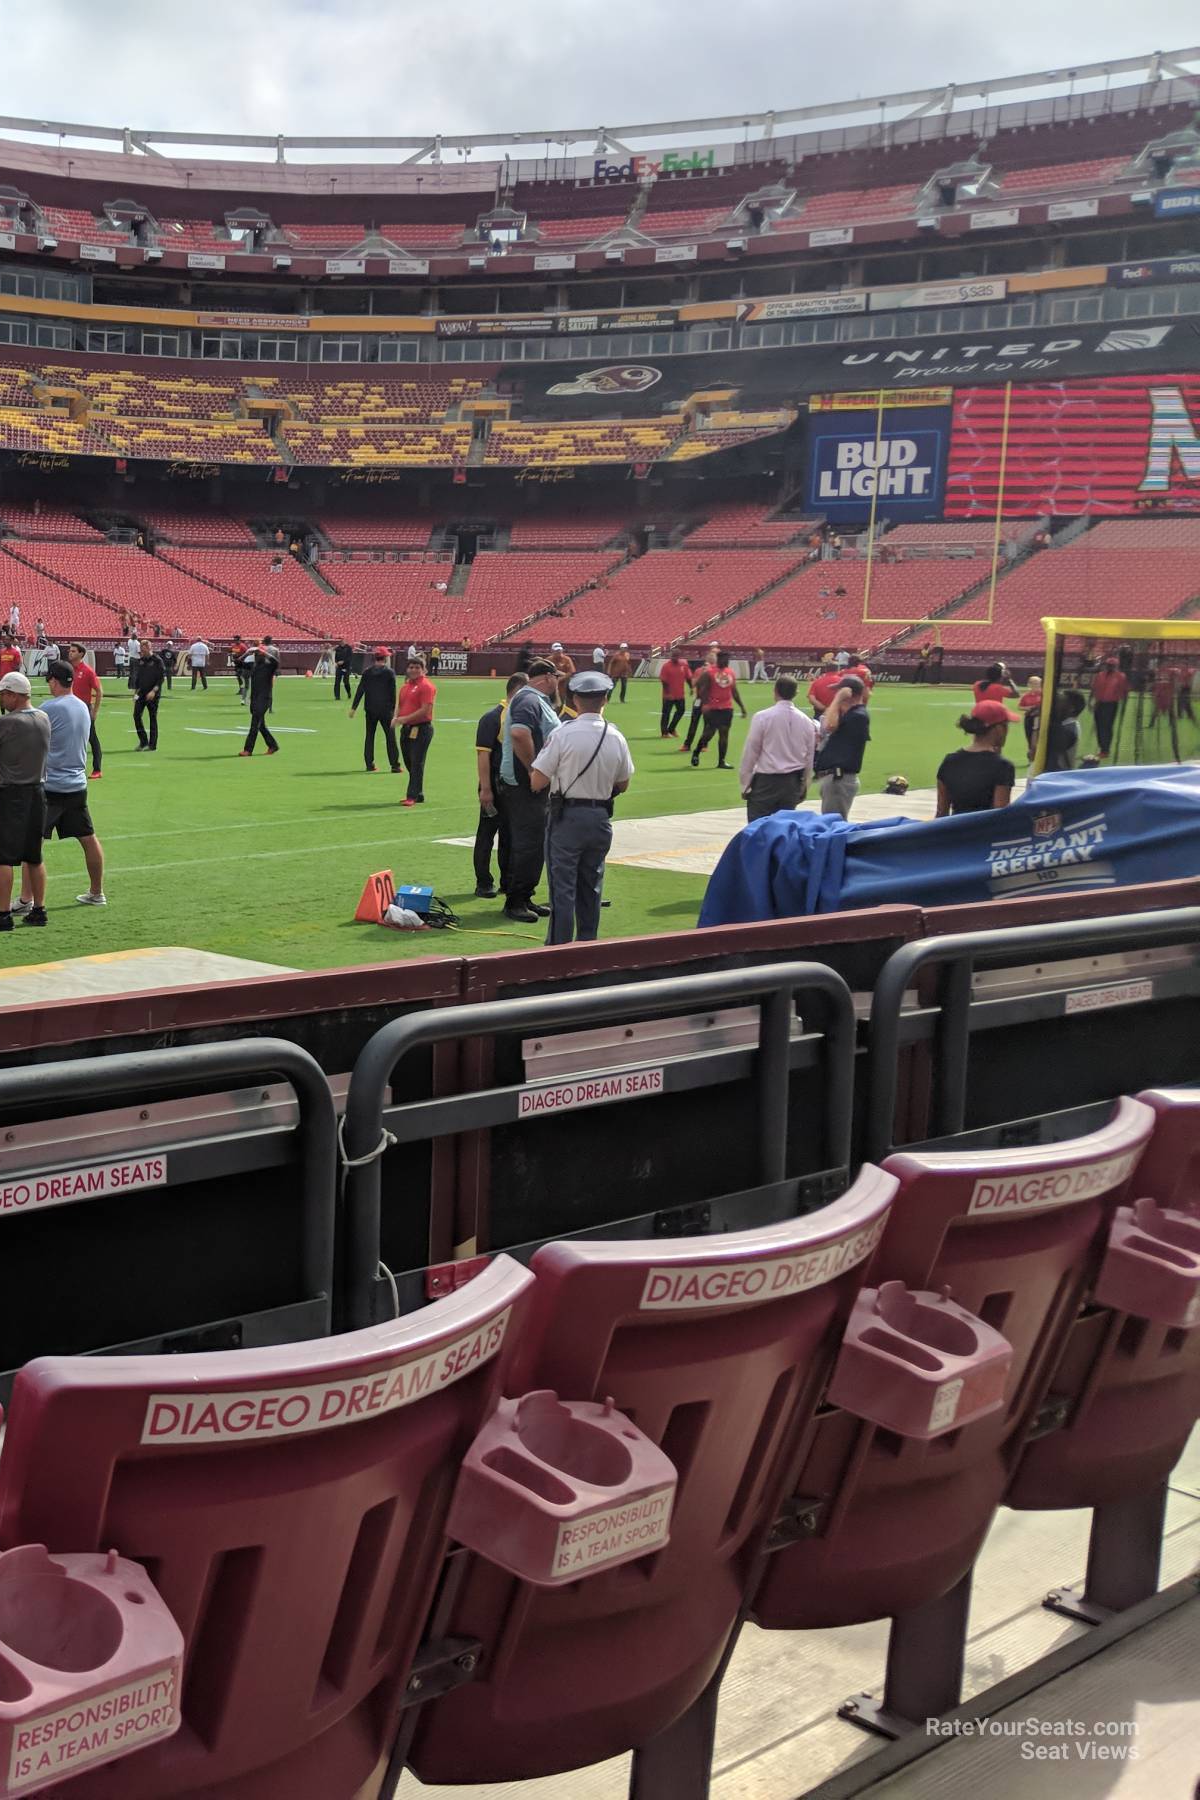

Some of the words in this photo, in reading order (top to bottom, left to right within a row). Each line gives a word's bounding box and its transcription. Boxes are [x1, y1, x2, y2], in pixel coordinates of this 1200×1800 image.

[594, 150, 713, 178] FedExField
[1162, 197, 1193, 210] BUD
[1122, 266, 1152, 279] FedEx
[767, 302, 794, 310] OFFICIAL
[970, 284, 994, 297] sas
[842, 339, 1083, 366] UNITED
[894, 362, 978, 379] Proud
[984, 360, 1014, 371] to
[1020, 357, 1060, 371] fly
[836, 440, 918, 470] BUD
[819, 467, 931, 497] LIGHT
[437, 660, 468, 671] ALUTE
[985, 823, 1108, 862] INSTANT
[991, 845, 1096, 878] REPLAY
[1036, 870, 1058, 881] HD
[375, 874, 396, 917] 20
[522, 1088, 573, 1112] DIAGEO
[576, 1079, 622, 1102] DREAM
[626, 1072, 661, 1093] SEATS
[35, 1172, 104, 1201] DREAM
[110, 1160, 163, 1187] SEATS
[973, 1173, 1071, 1209] DIAGEO
[645, 1262, 766, 1303] DIAGEO
[771, 1240, 849, 1291] DREAM
[148, 1393, 310, 1436] DIAGEO
[317, 1360, 436, 1422] DREAM
[440, 1317, 504, 1382] SEATS
[561, 1497, 668, 1546] RESPONSIBILITY
[557, 1553, 570, 1569] IS
[573, 1551, 583, 1564] A
[587, 1534, 622, 1557] TEAM
[624, 1519, 664, 1543] SPORT
[17, 1680, 173, 1753] RESPONSIBILITY
[14, 1757, 31, 1778] IS
[37, 1753, 51, 1770] A
[56, 1728, 109, 1762] TEAM
[113, 1706, 170, 1740] SPORT
